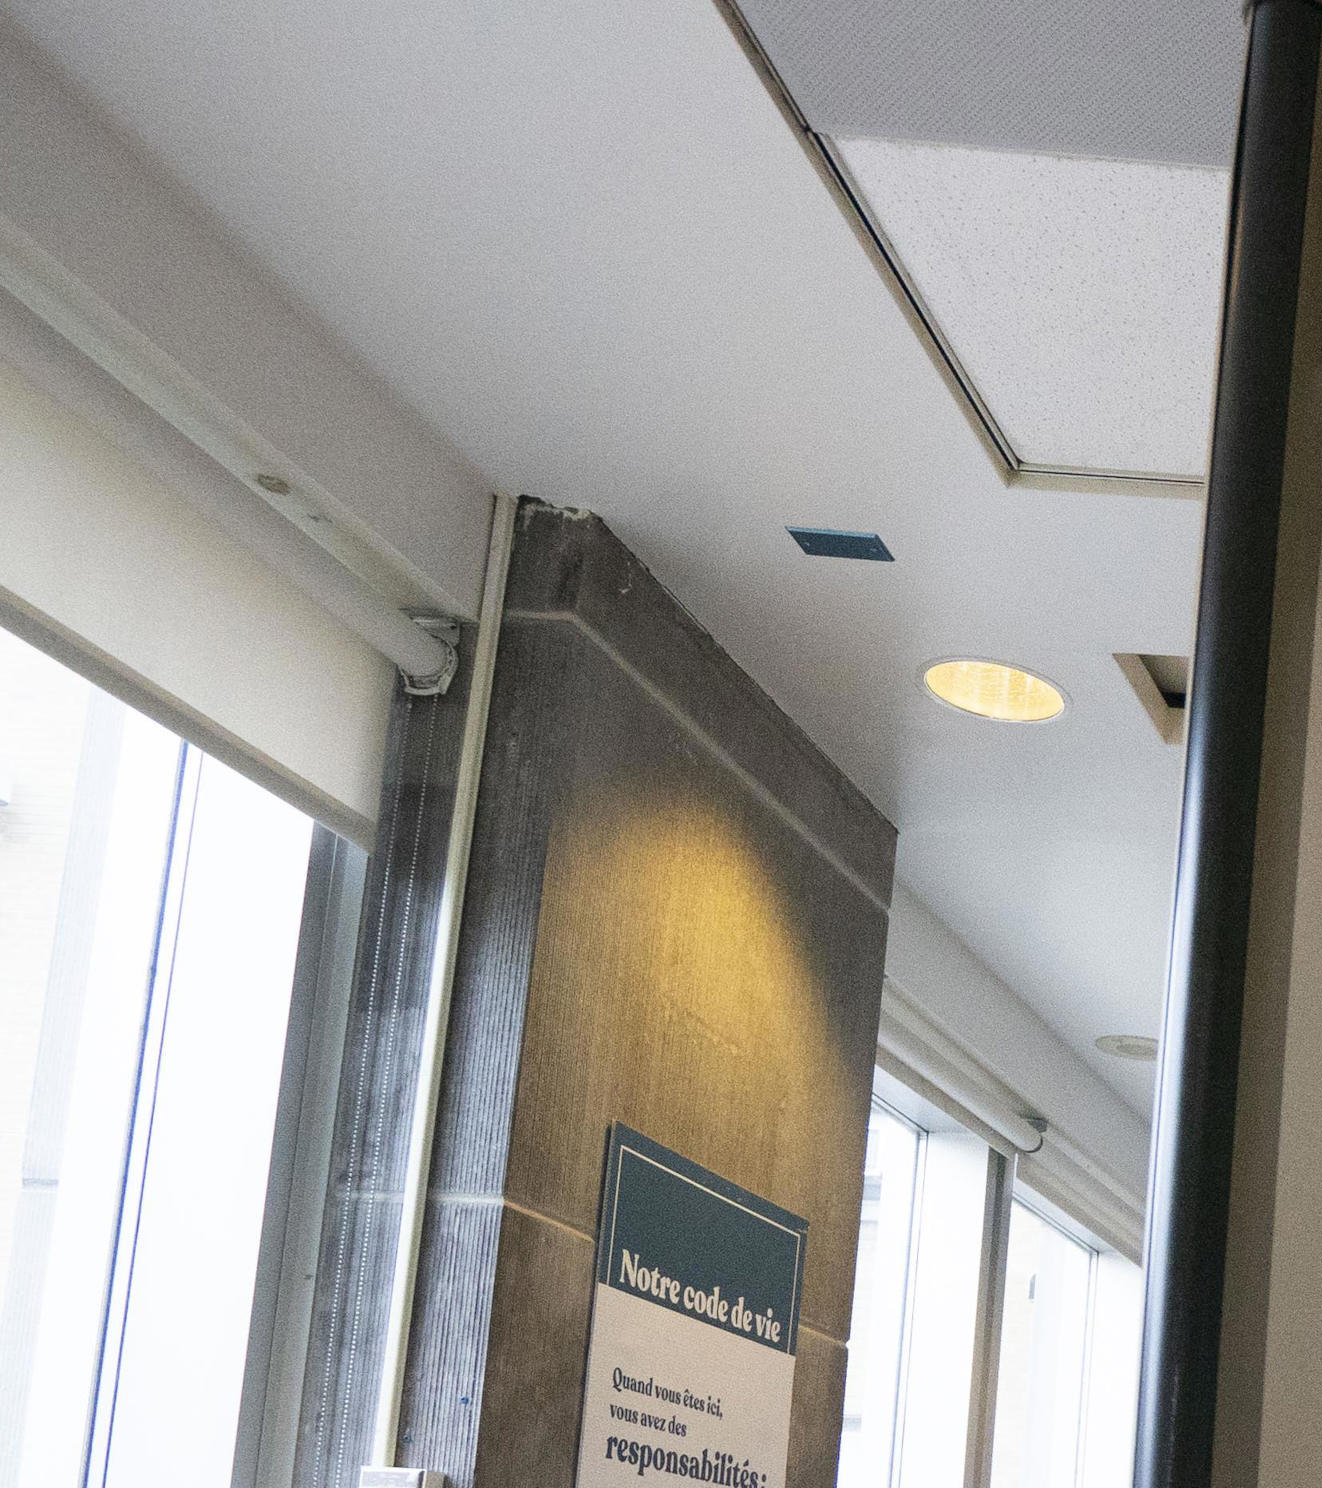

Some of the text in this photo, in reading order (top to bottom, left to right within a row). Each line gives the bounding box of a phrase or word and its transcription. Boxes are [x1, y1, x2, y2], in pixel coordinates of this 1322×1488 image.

[618, 1248, 782, 1343] Notre code de vie
[612, 1367, 724, 1420] Quand vous êtes ici,
[609, 1404, 687, 1438] vous avez des
